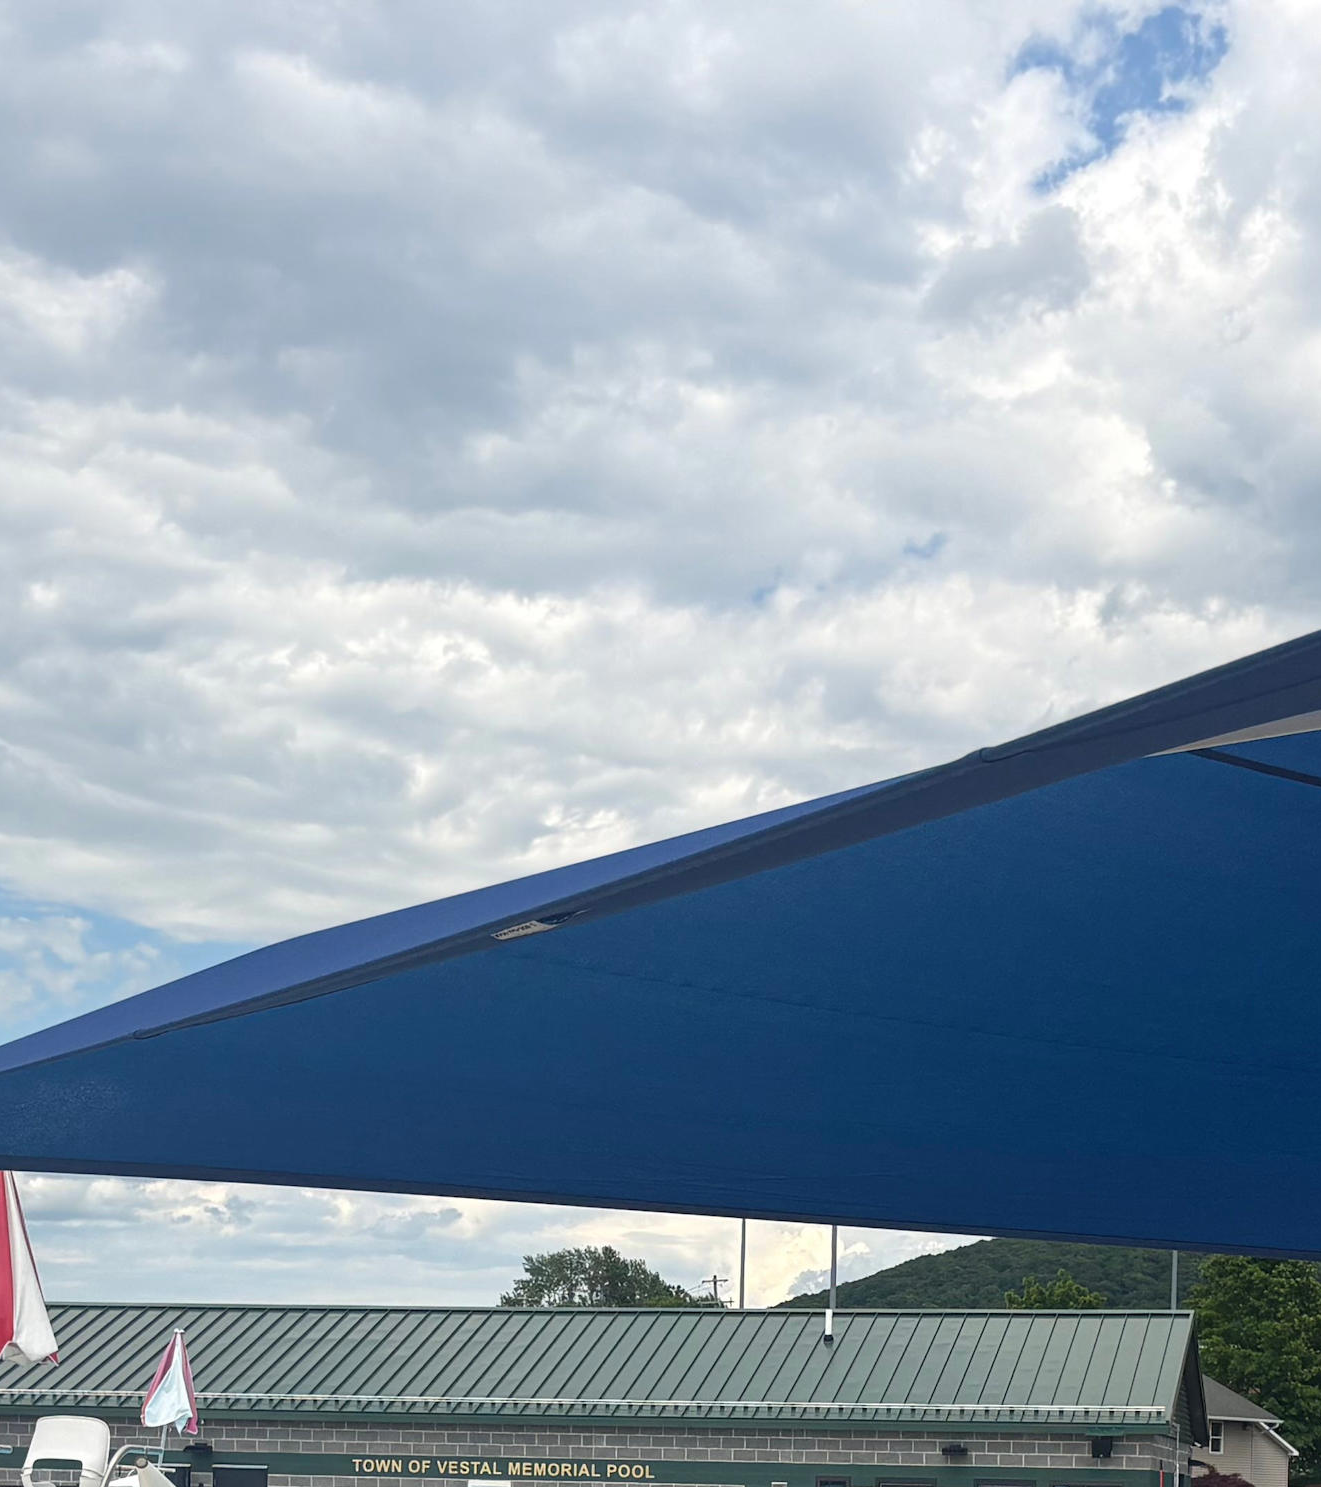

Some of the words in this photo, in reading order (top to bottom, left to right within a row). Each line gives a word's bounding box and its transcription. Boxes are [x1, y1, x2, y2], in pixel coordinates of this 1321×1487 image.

[352, 1459, 402, 1473] TOWN
[408, 1460, 431, 1474] OF
[437, 1460, 502, 1476] VESTAL
[508, 1462, 601, 1478] MEMORIAL
[606, 1464, 656, 1479] POOL
